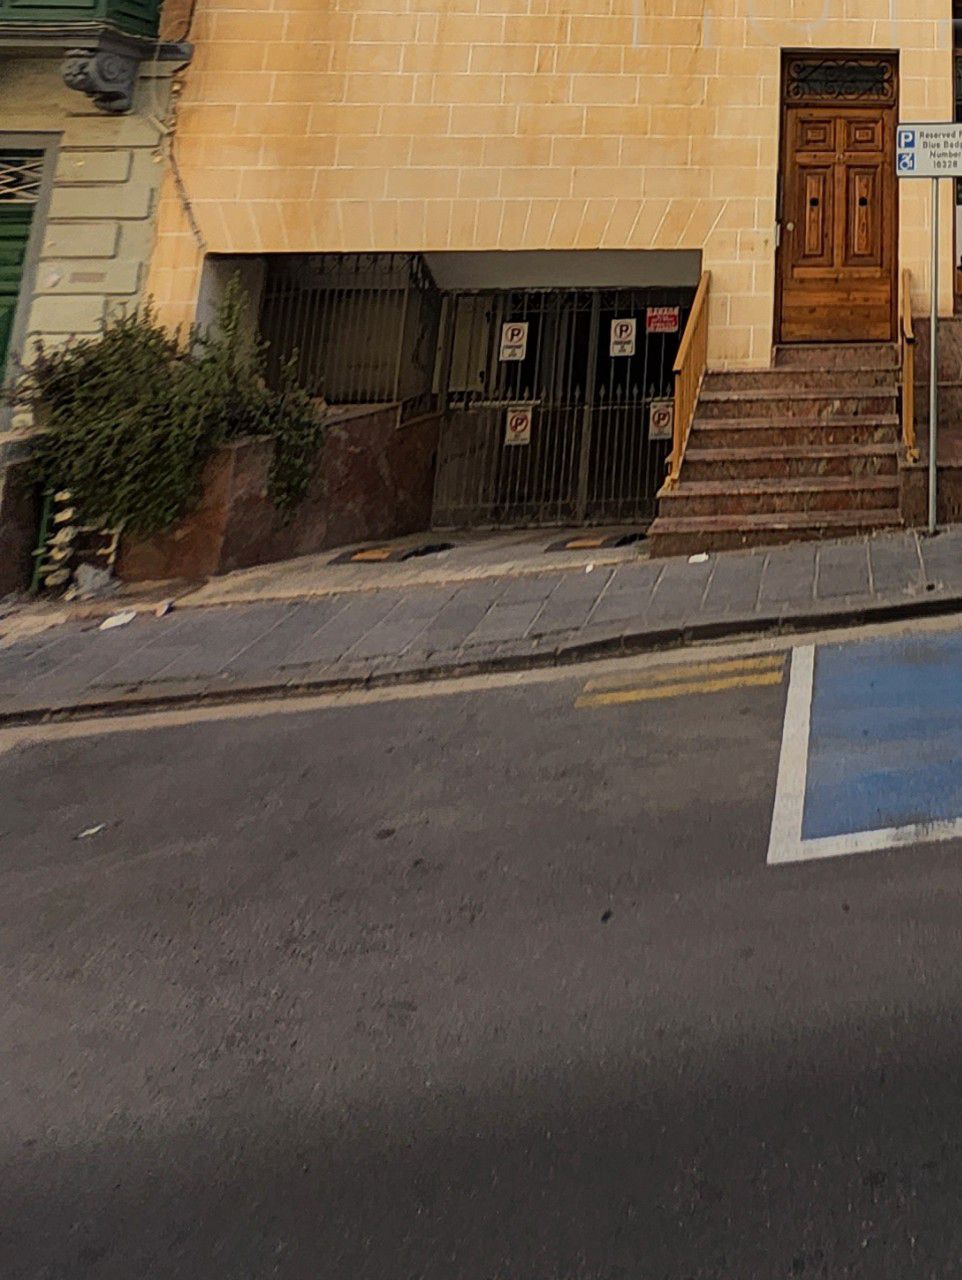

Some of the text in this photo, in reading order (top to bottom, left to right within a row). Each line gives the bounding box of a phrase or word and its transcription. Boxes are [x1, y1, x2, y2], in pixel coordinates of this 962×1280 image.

[919, 131, 957, 139] Reserved
[922, 141, 940, 149] Blue
[929, 150, 961, 159] Number
